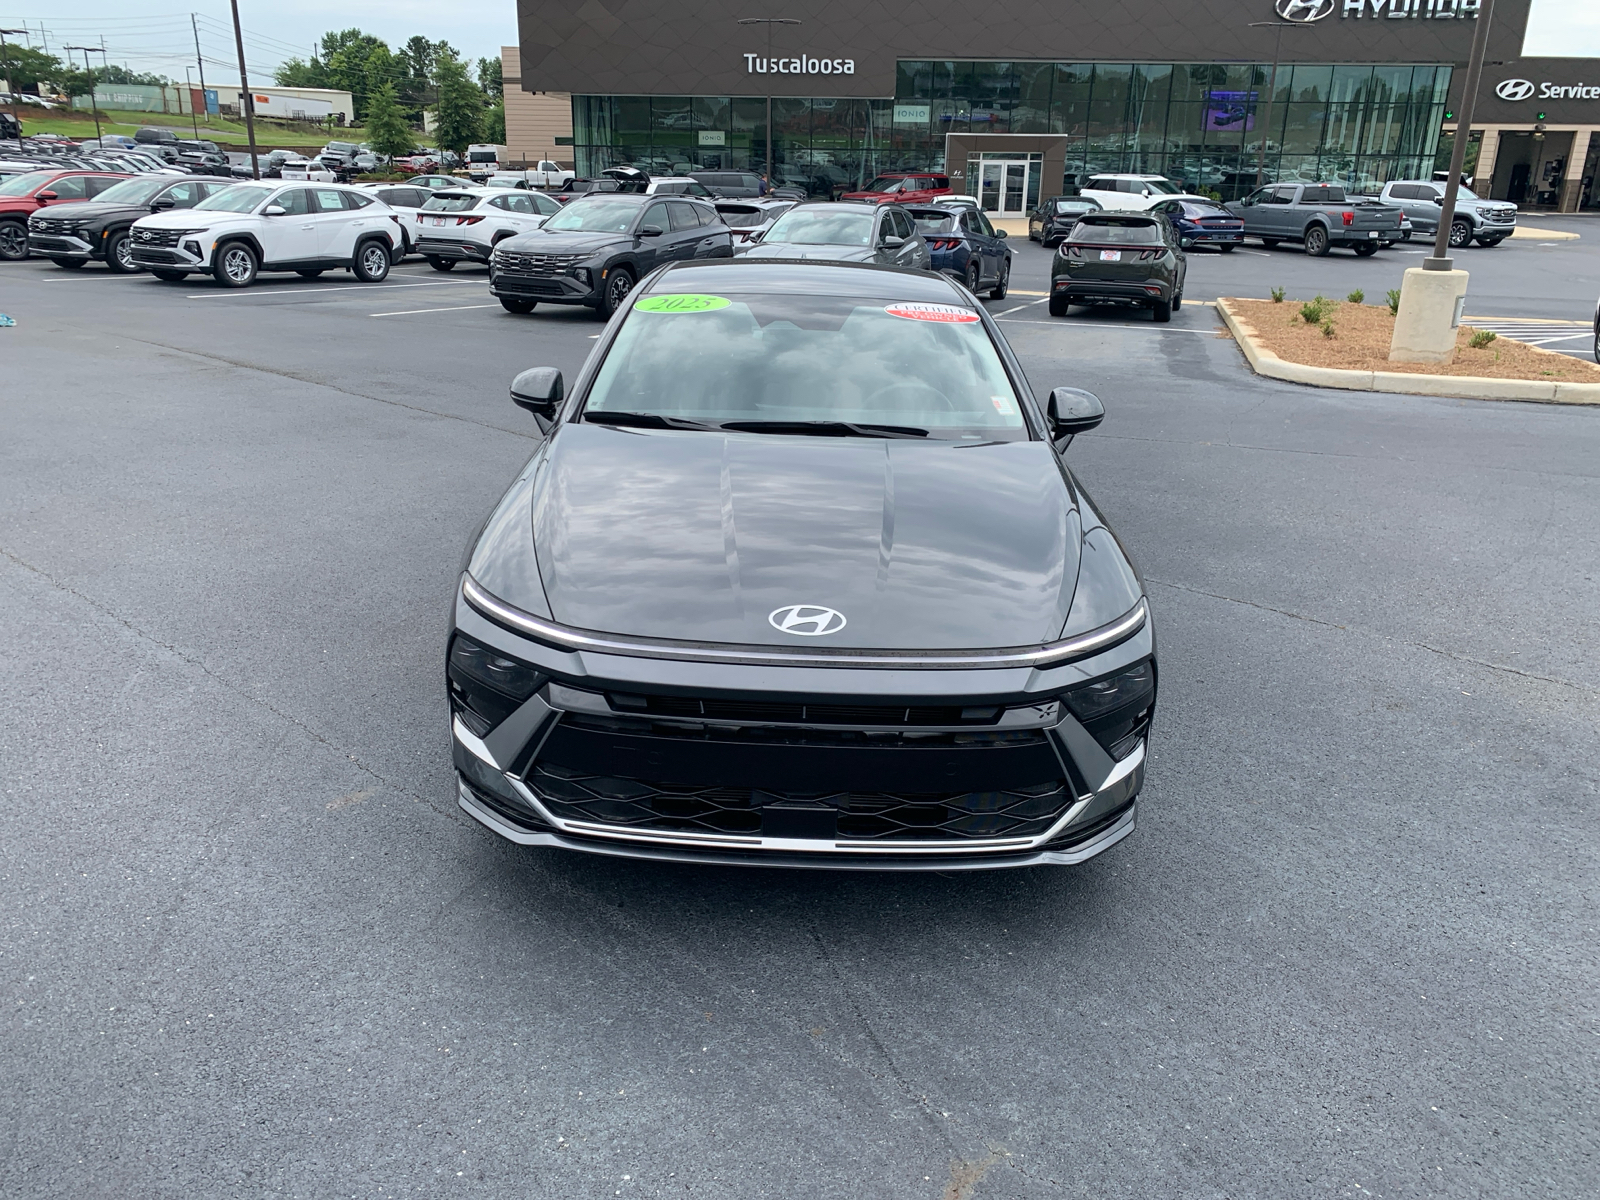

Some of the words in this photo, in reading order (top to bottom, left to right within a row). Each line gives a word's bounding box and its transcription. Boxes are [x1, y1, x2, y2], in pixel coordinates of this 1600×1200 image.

[1342, 0, 1479, 18] HYUNDA
[743, 53, 855, 74] Tuscaloosa
[1538, 82, 1600, 99] Service
[648, 298, 717, 310] 2025
[894, 304, 969, 315] CERTIFIED
